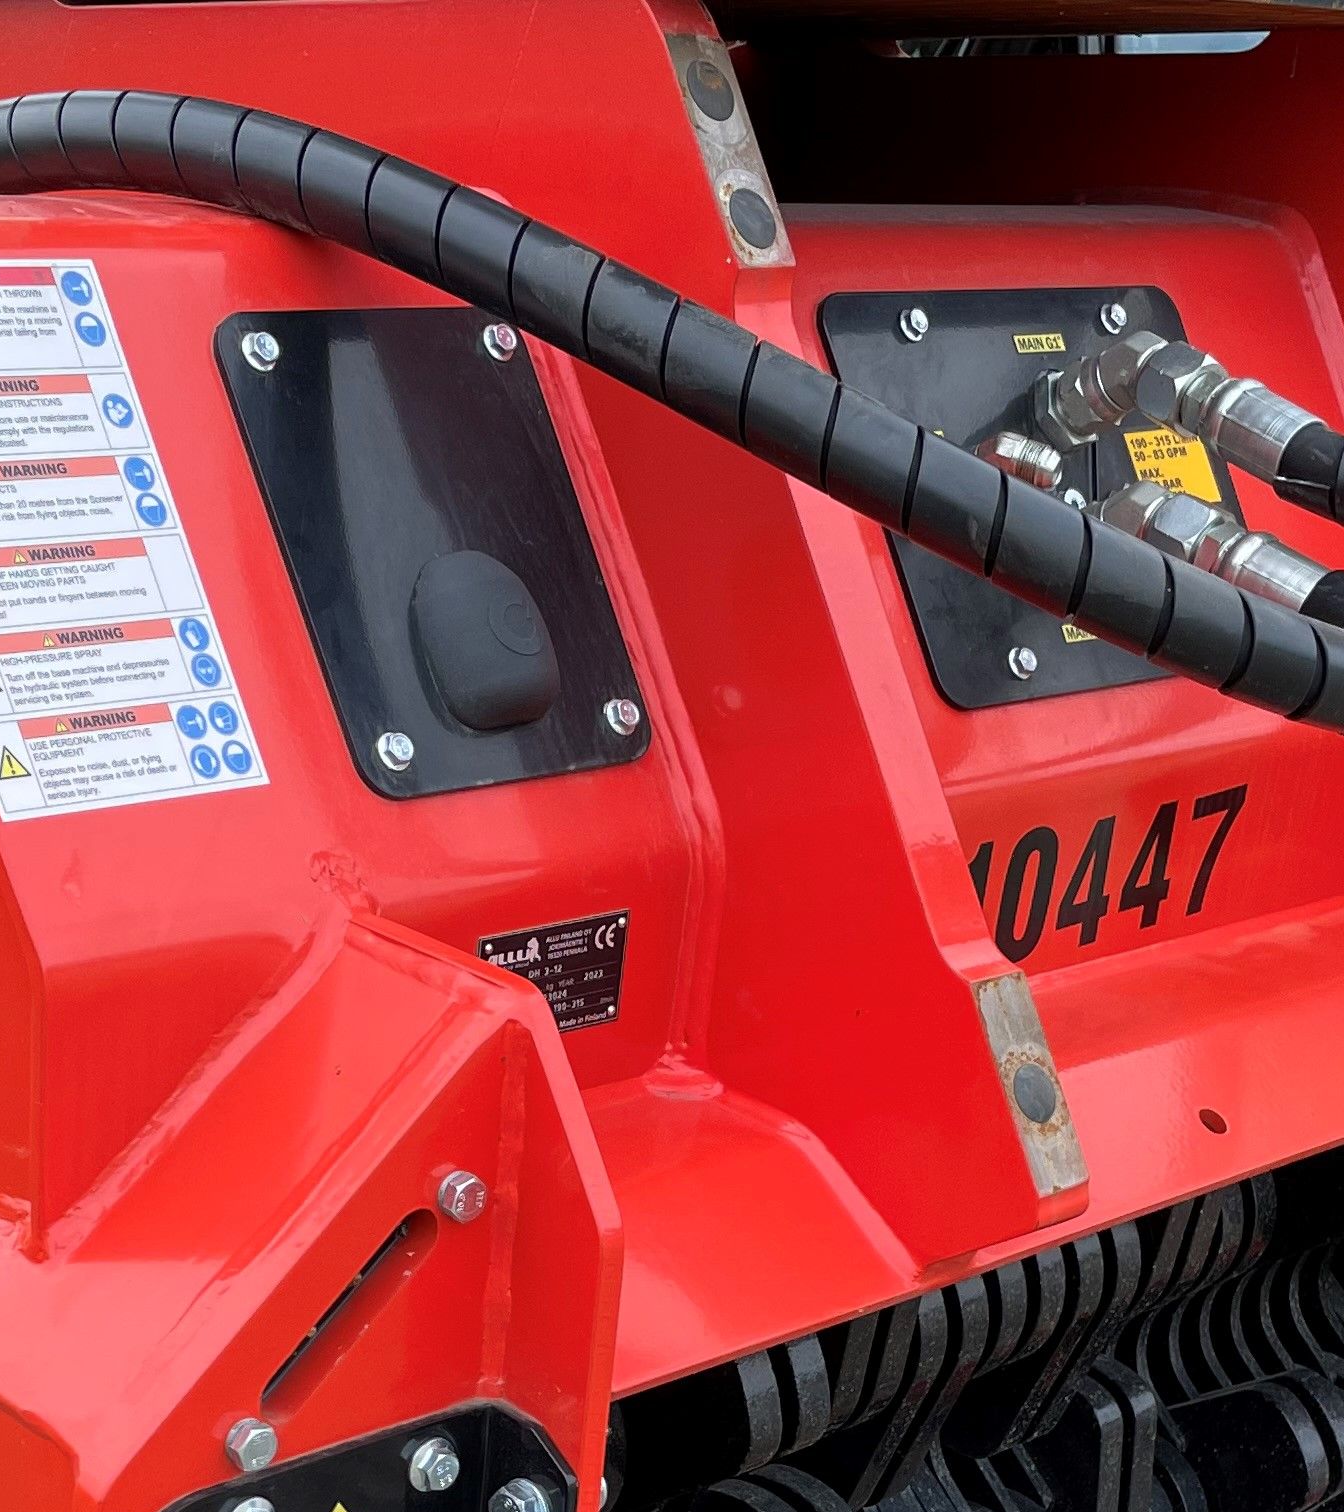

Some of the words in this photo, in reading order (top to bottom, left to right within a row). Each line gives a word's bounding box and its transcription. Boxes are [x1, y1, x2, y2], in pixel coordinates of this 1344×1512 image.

[1018, 337, 1044, 350] MAIN
[1167, 447, 1187, 458] GPM
[0, 463, 68, 477] WARNING
[27, 546, 95, 560] WARNING
[8, 569, 38, 578] HANDS
[41, 566, 78, 576] GETTING
[80, 562, 115, 573] CAUGHT
[21, 578, 56, 589] MOVING
[57, 576, 86, 586] PARTS
[56, 628, 124, 644] WARNING
[0, 652, 72, 666] HIGH-PRESSURE
[75, 649, 102, 658] SPRAY
[68, 712, 136, 729] WARNING
[29, 741, 48, 751] USE
[51, 735, 97, 748] PERSONAL
[98, 728, 152, 742] PROTECTIVE
[33, 748, 85, 761] EQUIPMENT
[528, 969, 540, 978] DH
